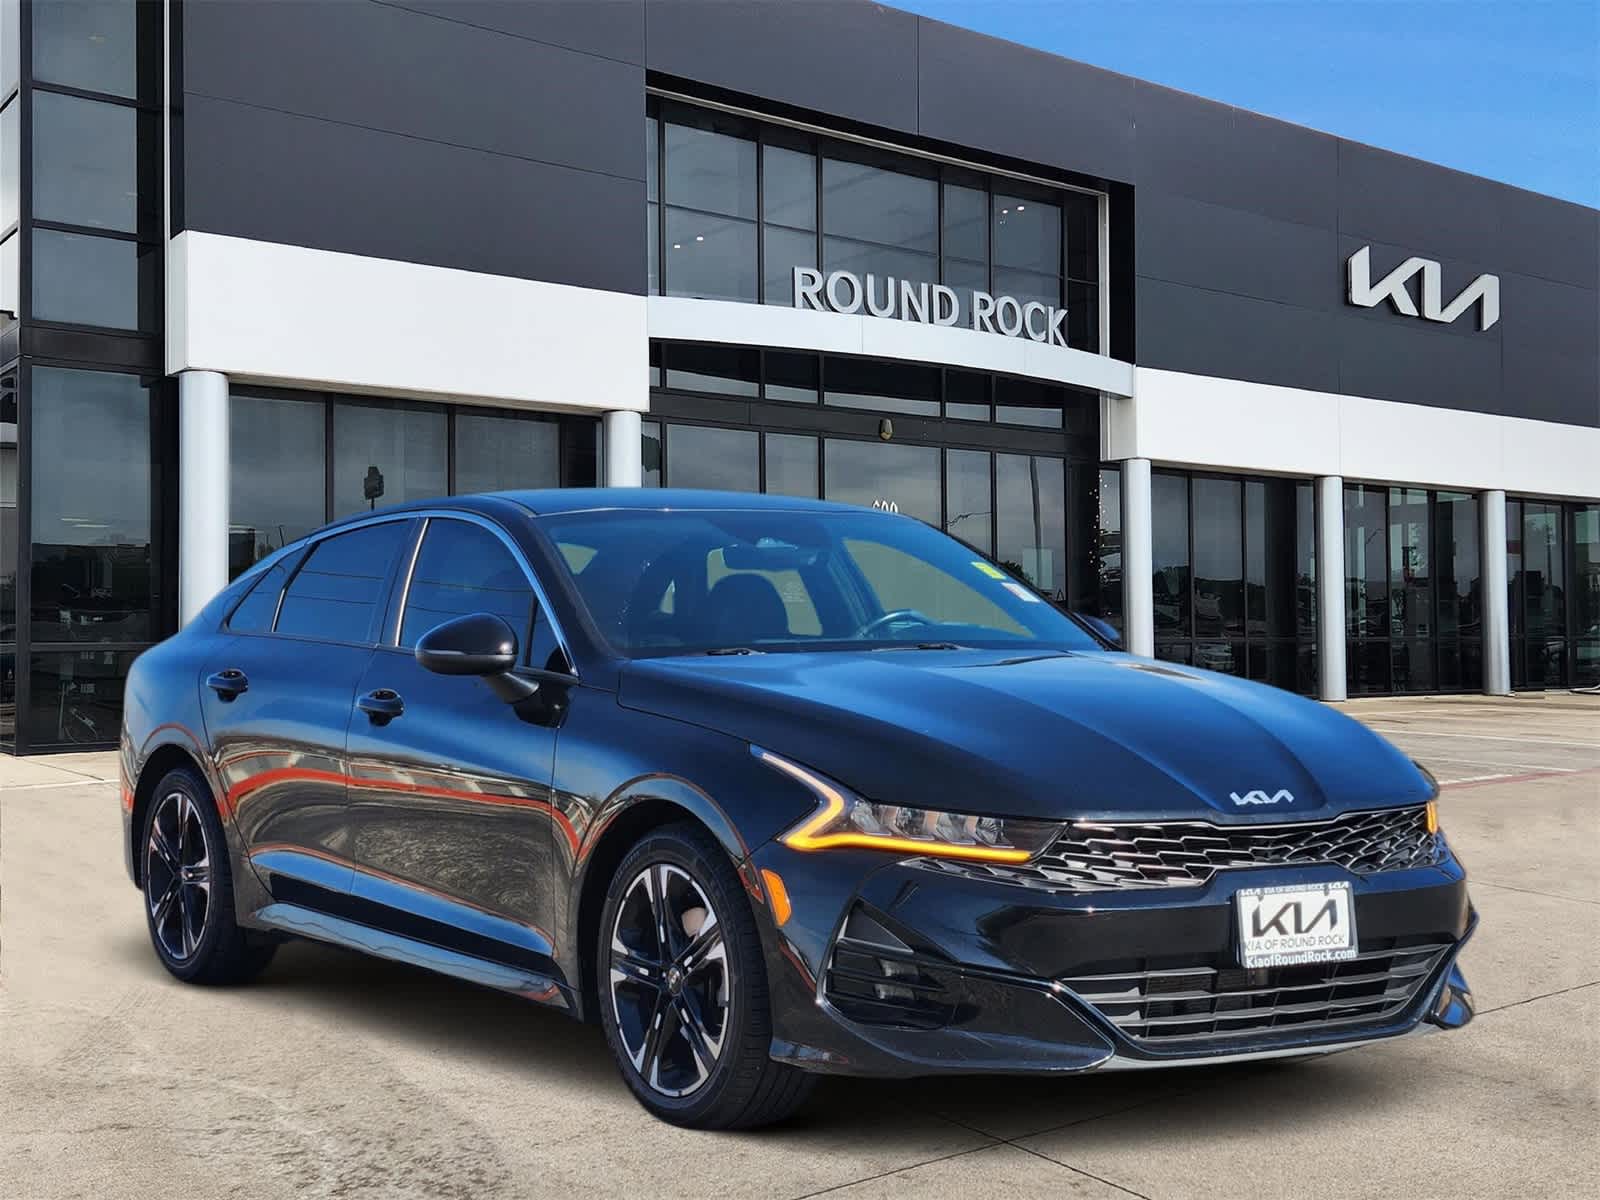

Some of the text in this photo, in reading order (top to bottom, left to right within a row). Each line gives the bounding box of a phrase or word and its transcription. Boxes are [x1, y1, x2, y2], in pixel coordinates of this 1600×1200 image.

[1347, 245, 1500, 331] KIA
[793, 266, 1069, 348] ROUND ROCK
[1230, 789, 1294, 806] KIA
[1252, 899, 1338, 938] KIA
[1246, 935, 1344, 952] KIA OF ROUND ROCK
[1246, 949, 1357, 969] KiaofRoundRock.com
